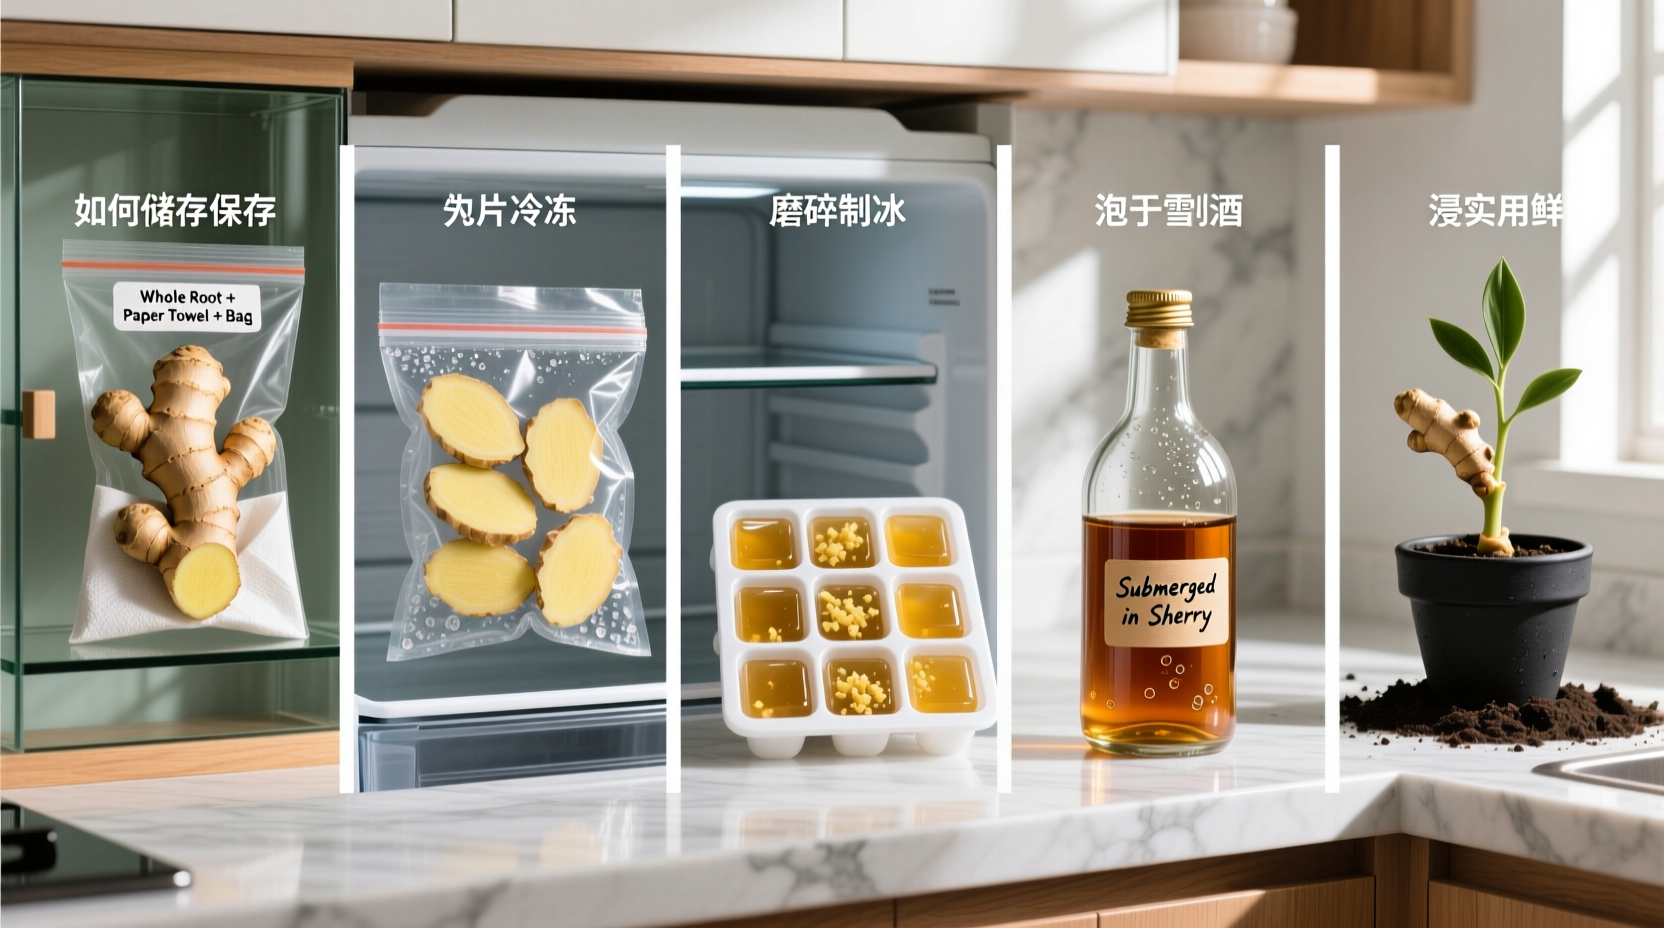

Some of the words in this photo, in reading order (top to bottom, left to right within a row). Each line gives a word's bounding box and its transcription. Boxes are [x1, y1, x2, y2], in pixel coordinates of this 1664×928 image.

[140, 289, 186, 304] Whole
[190, 290, 223, 305] Root
[123, 308, 165, 325] Paper
[168, 308, 209, 322] Towel
[226, 309, 253, 326] Bag
[1115, 572, 1217, 604] Submerged
[1121, 606, 1139, 626] in
[1147, 602, 1212, 633] Sherry
